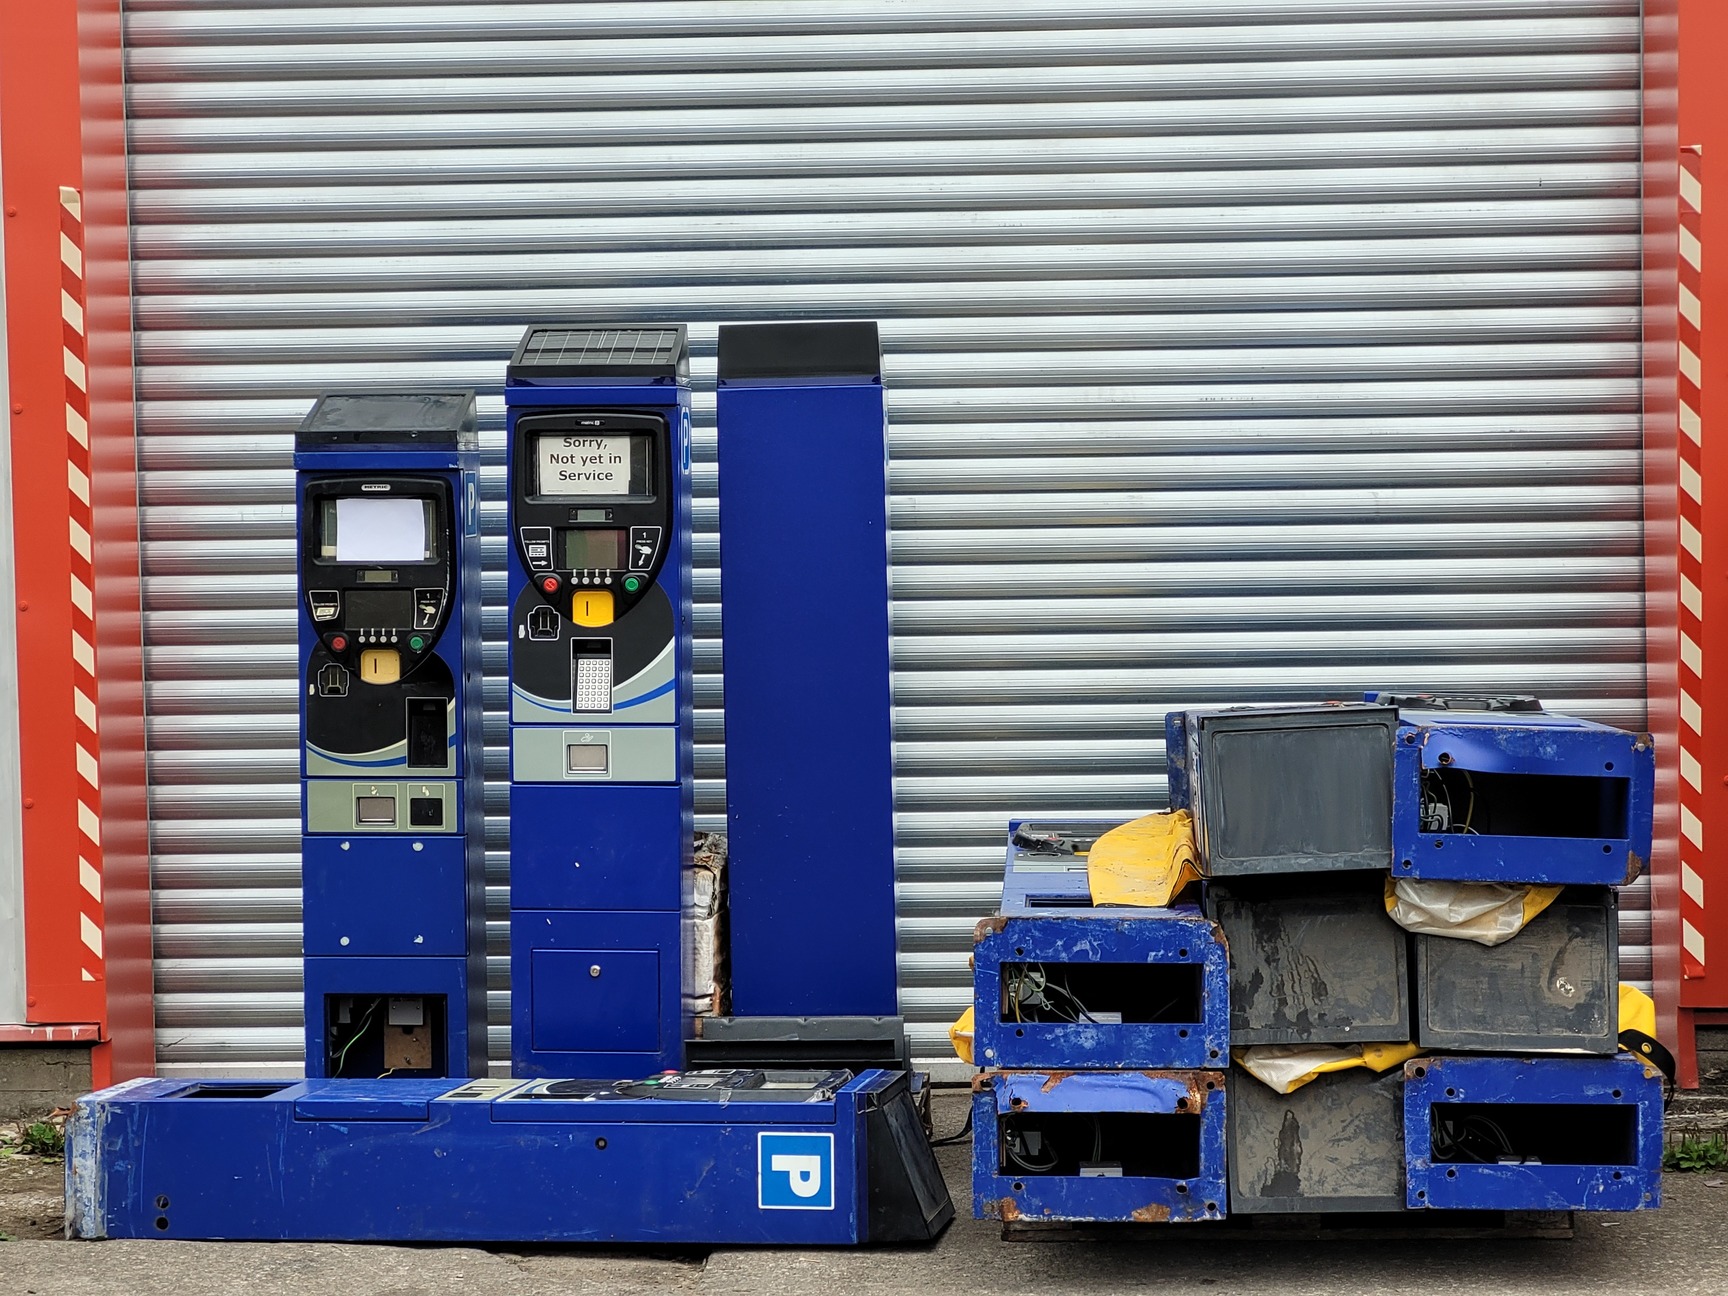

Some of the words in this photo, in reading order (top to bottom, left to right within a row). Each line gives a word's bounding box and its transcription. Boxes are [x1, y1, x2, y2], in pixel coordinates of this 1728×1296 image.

[563, 437, 608, 450] Sorry,
[549, 453, 576, 465] Not
[580, 454, 604, 466] yet
[608, 453, 622, 464] in
[558, 470, 614, 481] Service
[467, 482, 475, 526] P
[771, 1154, 821, 1198] P
